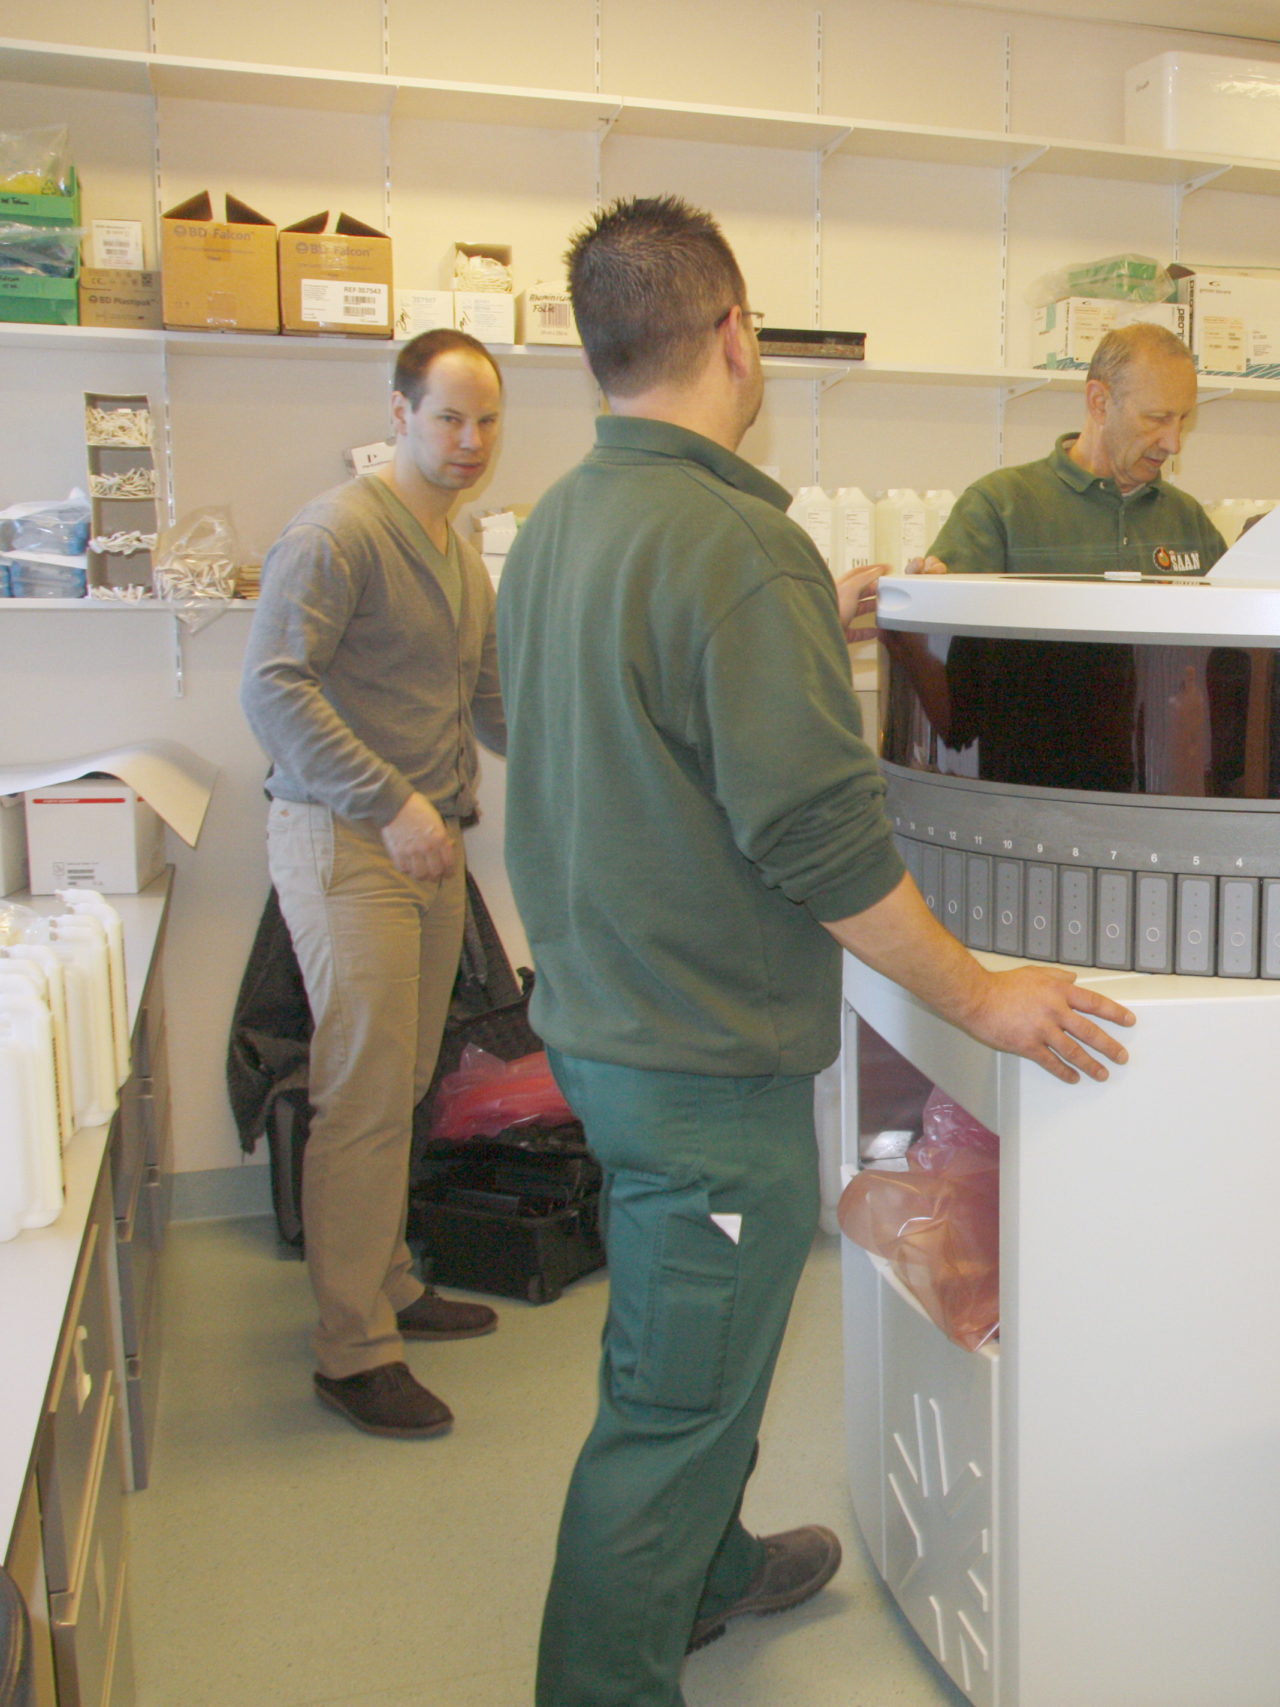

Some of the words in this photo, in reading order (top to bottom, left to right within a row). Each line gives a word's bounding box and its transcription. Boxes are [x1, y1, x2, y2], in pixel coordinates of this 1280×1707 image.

[188, 226, 208, 238] BD
[949, 831, 957, 841] 12
[974, 836, 983, 845] 11
[1002, 839, 1013, 849] 10
[1036, 843, 1044, 853] 9
[1072, 847, 1080, 857] 8
[1110, 850, 1118, 861] 7
[1150, 852, 1159, 864] 6
[1192, 855, 1201, 866] 5
[1235, 857, 1244, 868] 4
